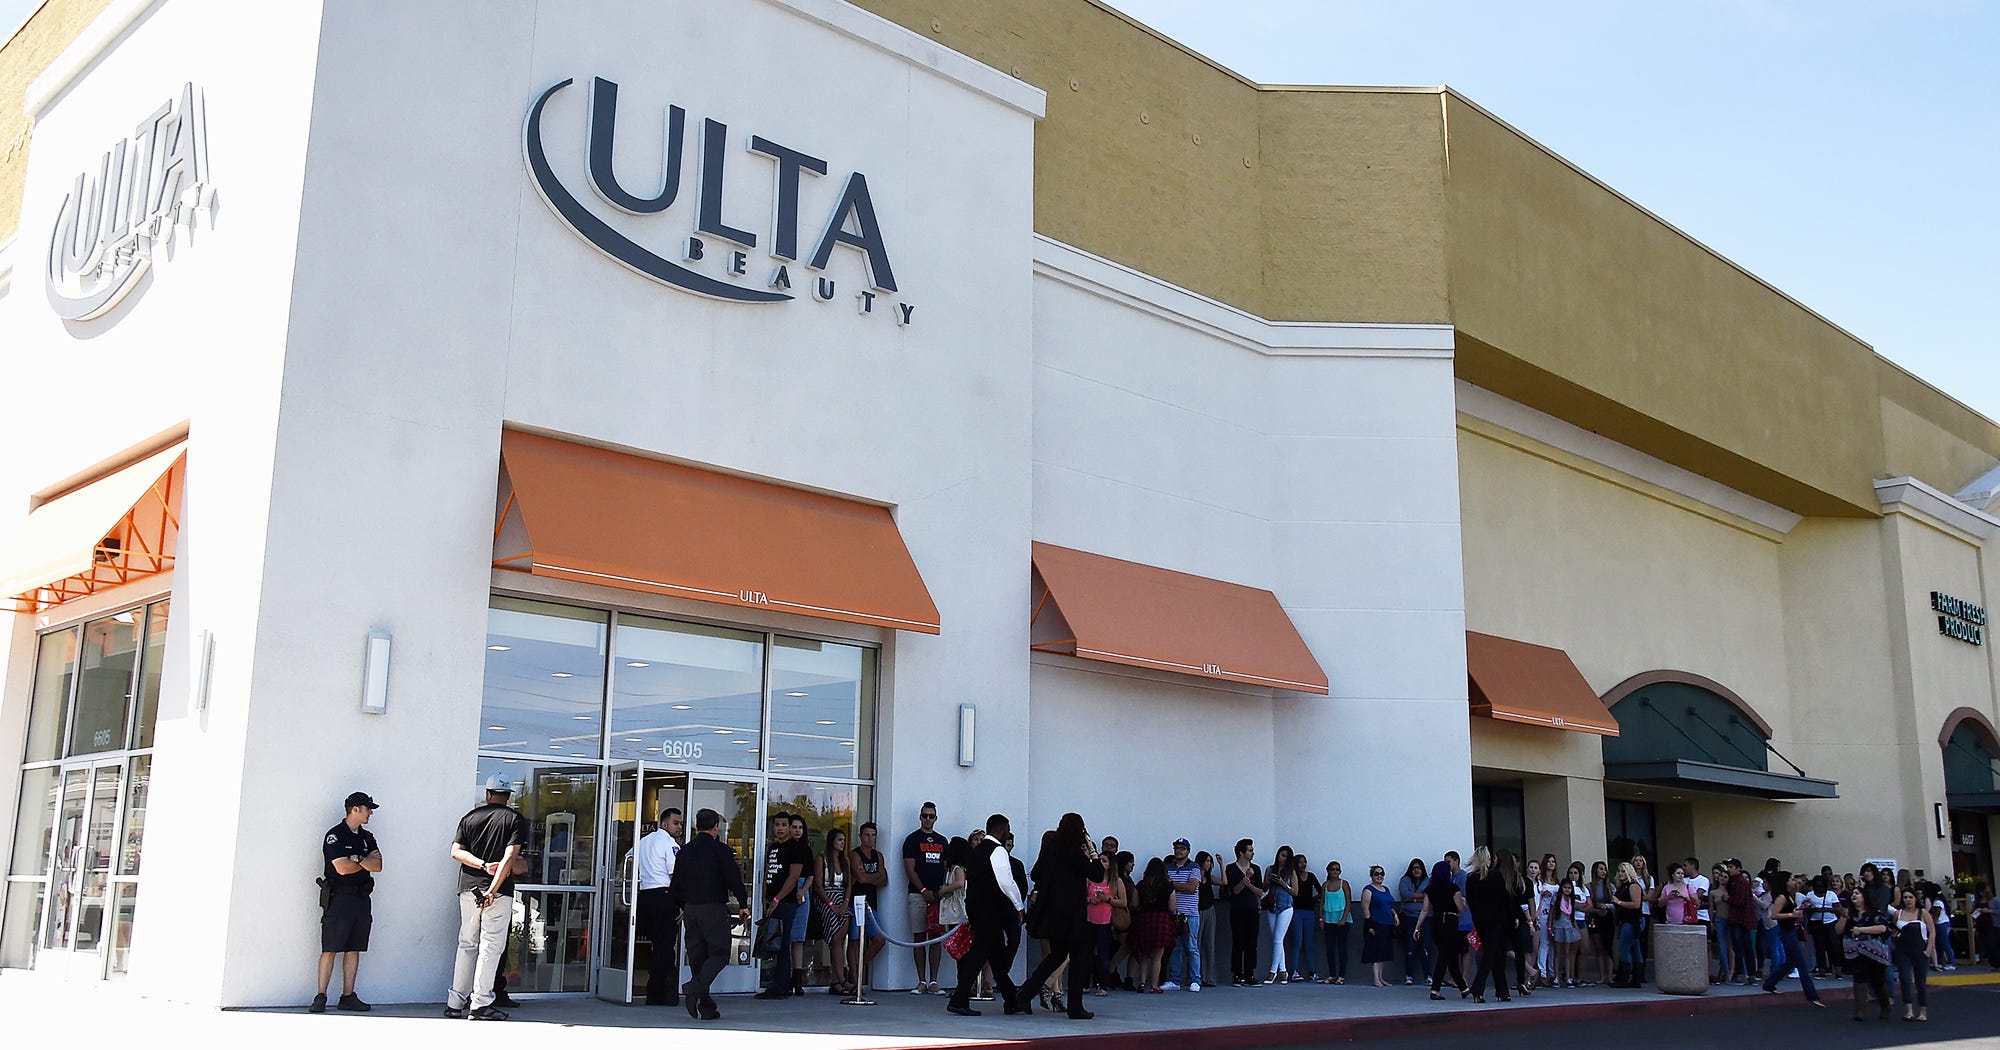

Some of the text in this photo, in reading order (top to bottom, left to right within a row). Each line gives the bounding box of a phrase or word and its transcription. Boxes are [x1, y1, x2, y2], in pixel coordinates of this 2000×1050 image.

[66, 81, 198, 274] ULTA
[586, 75, 898, 293] ULTA
[685, 236, 915, 326] BEAUTY
[739, 589, 769, 605] ULTA
[1932, 592, 1961, 616] FARM
[1203, 663, 1221, 675] ULTA
[662, 739, 703, 759] 6605
[641, 823, 656, 832] LTA
